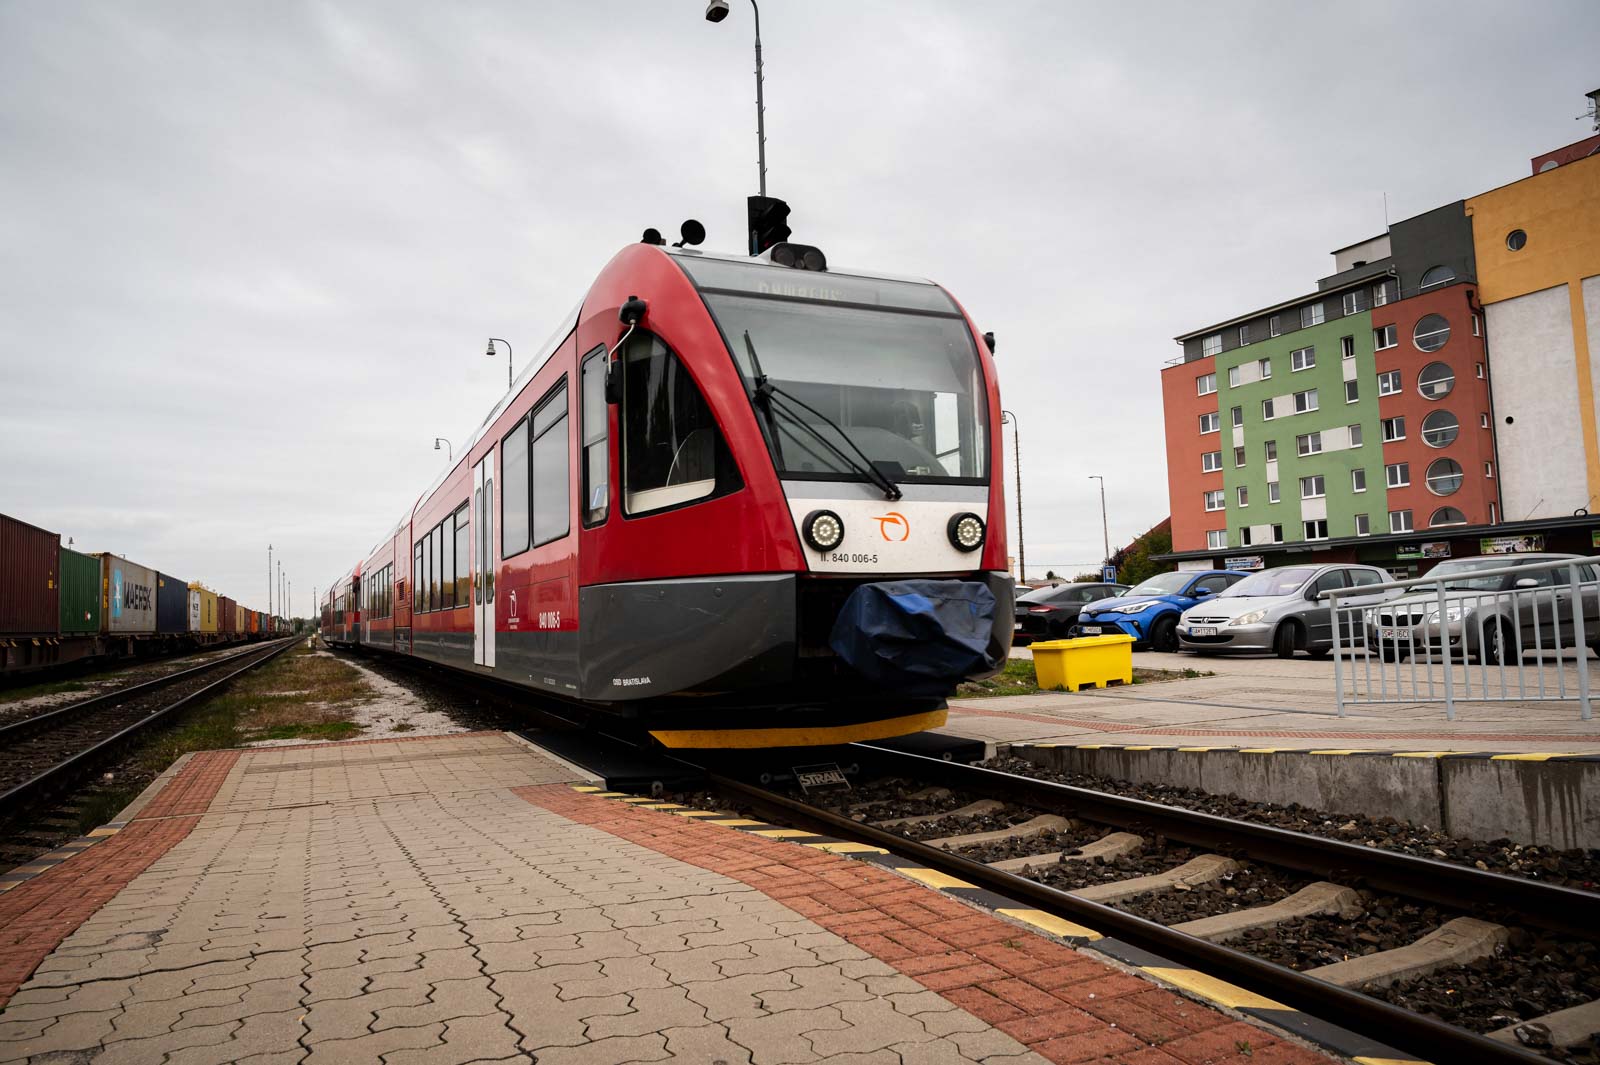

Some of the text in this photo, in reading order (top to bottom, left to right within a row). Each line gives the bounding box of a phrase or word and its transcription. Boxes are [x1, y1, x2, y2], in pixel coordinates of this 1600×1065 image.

[832, 553, 849, 563] 840
[851, 553, 878, 564] 006-5
[123, 581, 152, 612] MAERSK
[538, 610, 560, 629] 840 006-5
[623, 676, 652, 687] BRATISLAVA
[799, 771, 846, 785] STRAIL
